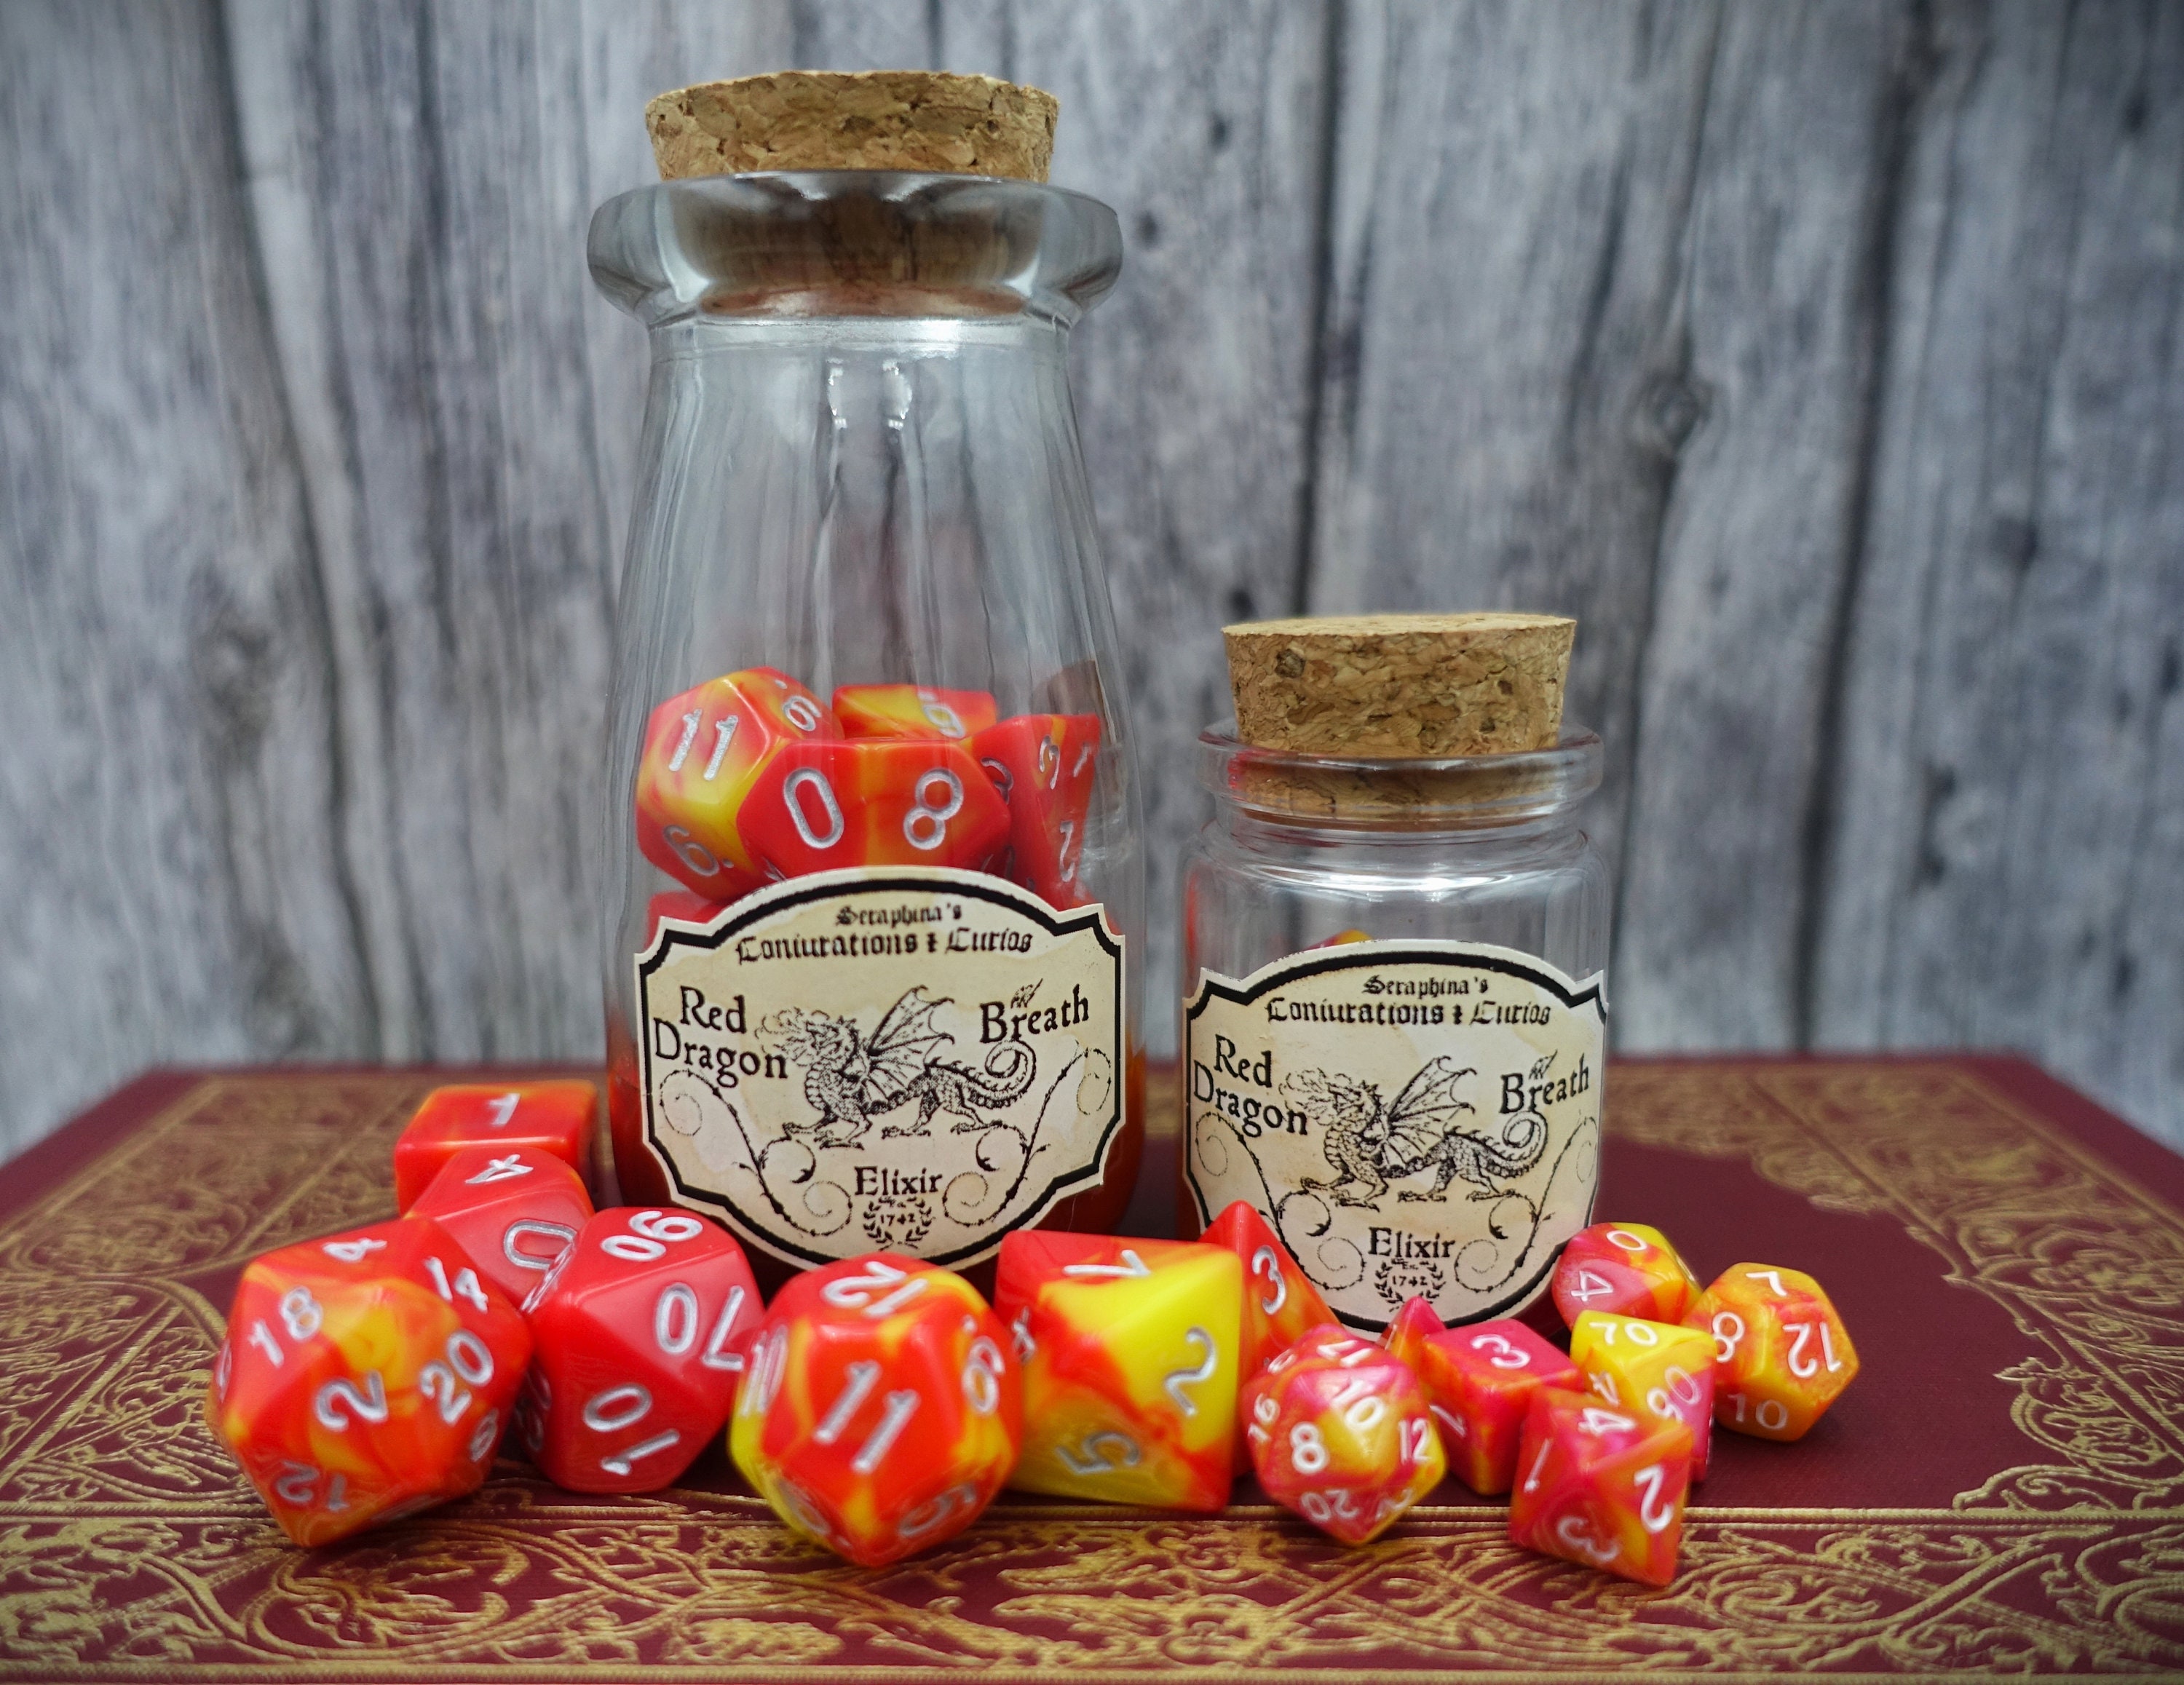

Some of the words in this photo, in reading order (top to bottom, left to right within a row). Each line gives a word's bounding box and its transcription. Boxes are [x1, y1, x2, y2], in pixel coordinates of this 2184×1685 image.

[903, 768, 964, 850] 8
[835, 903, 963, 929] Seraphina's
[945, 927, 1034, 955] Curios
[680, 985, 747, 1034] Red
[979, 983, 1089, 1044] Breath
[1361, 974, 1489, 1000] Seraphina's
[653, 1017, 788, 1089] Dragon
[1214, 1033, 1273, 1088] Red
[1193, 1059, 1308, 1138] Dragon
[1499, 1052, 1589, 1114] Breath
[854, 1165, 943, 1196] Elixir
[1368, 1226, 1456, 1258] Elixir
[422, 1256, 488, 1312] 14
[1251, 1245, 1286, 1315] 3
[1570, 1269, 1615, 1303] 4
[249, 1285, 323, 1368] 18
[1470, 1333, 1531, 1369] 3
[1588, 1321, 1658, 1347] 70
[420, 1329, 494, 1426] 20
[1164, 1325, 1219, 1416] 2
[315, 1369, 389, 1432] 2
[812, 1359, 922, 1474] 11
[1330, 1379, 1387, 1431] 10
[1578, 1407, 1637, 1434] 4
[1727, 1392, 1789, 1430] 10
[1289, 1421, 1329, 1475] 8
[1398, 1416, 1432, 1465] 12
[1634, 1465, 1674, 1533] 2
[1558, 1515, 1623, 1563] 3
